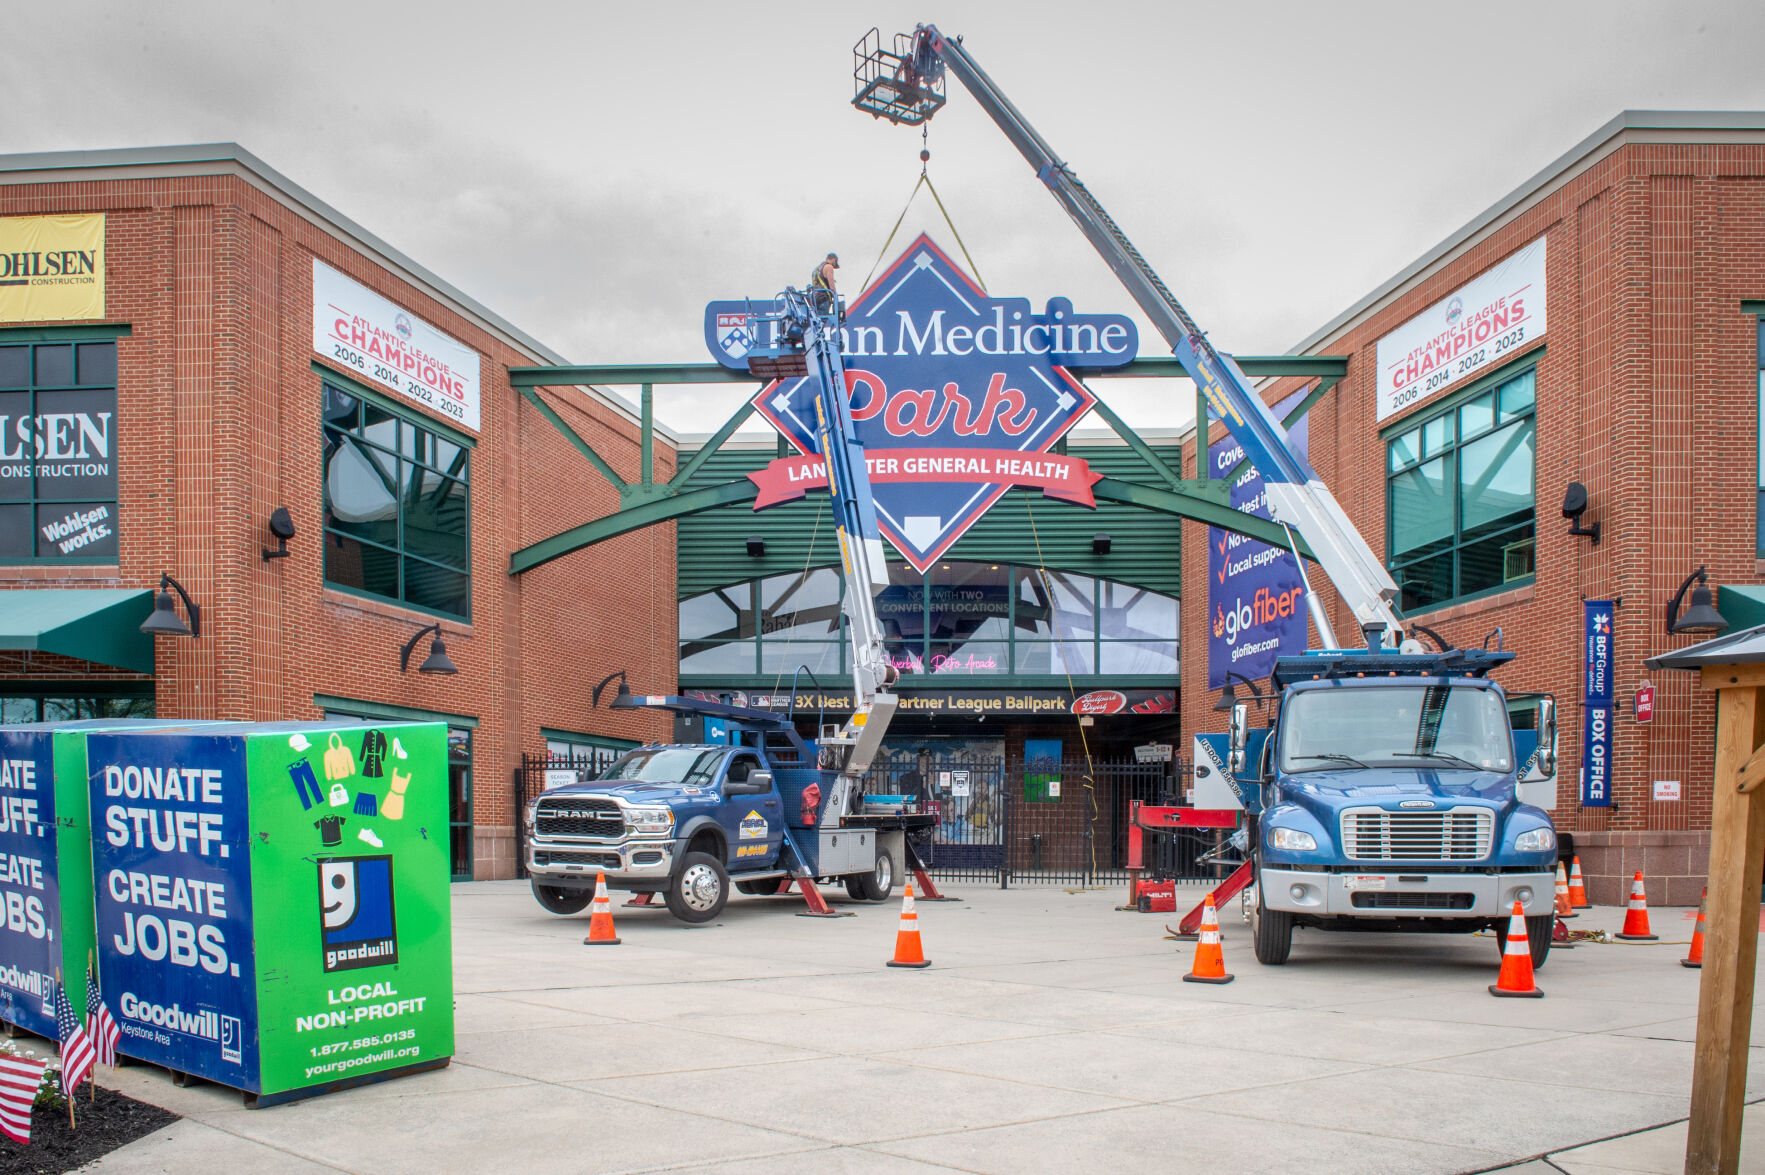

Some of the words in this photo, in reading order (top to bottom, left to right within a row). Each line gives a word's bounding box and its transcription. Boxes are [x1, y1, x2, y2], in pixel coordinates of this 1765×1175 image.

[32, 277, 95, 285] CONSTRUCTION
[352, 315, 407, 351] ATLANTIC
[410, 345, 450, 375] LEAGUE
[895, 306, 1129, 356] Medicine
[1393, 299, 1525, 388] CHAMPIONS
[1407, 327, 1457, 363] ATLANTIC
[1460, 297, 1506, 332] LEAGUE
[335, 319, 464, 400] CHAMPIONS
[1393, 387, 1418, 409] 2006
[1426, 370, 1449, 391] 2014
[1458, 350, 1486, 374] 2022
[1496, 327, 1525, 353] 2023
[334, 344, 364, 369] 2006
[374, 364, 399, 386] 2014
[408, 382, 433, 403] 2022
[441, 398, 464, 419] 2023
[841, 368, 1037, 436] Park
[788, 457, 899, 482] LANTER
[904, 457, 991, 474] GENERAL
[995, 459, 1070, 480] HEALTH
[42, 505, 109, 543] Wohlsen
[58, 522, 112, 554] works.
[1228, 553, 1253, 577] Local
[881, 603, 949, 613] CONVENENT
[951, 603, 1009, 613] LOCATIONS
[934, 591, 958, 600] WITH
[961, 591, 984, 600] TWO
[965, 653, 997, 674] Arcade
[1231, 637, 1279, 662] glofiber.com
[795, 695, 814, 708] 3X
[818, 695, 850, 708] Best
[898, 696, 943, 710] artner
[948, 696, 1002, 712] League
[1005, 695, 1065, 712] Ballpark
[1592, 709, 1606, 742] BOX
[1201, 738, 1224, 766] USDOT
[105, 765, 223, 803] DONATE
[1221, 767, 1243, 796] 956596
[1590, 745, 1606, 799] OFFICE
[557, 810, 594, 818] RAM
[106, 805, 229, 858] STUFF.
[108, 869, 227, 918] CREATE
[114, 912, 240, 978] JOBS.
[327, 940, 394, 968] goodwill
[328, 982, 397, 1005] LOCAL
[120, 992, 219, 1040] Goodwill
[296, 997, 426, 1033] NON-PROFIT
[121, 1021, 154, 1041] Keystone
[155, 1030, 171, 1046] Area
[310, 1029, 416, 1057] 1.877.585.0135
[305, 1046, 420, 1078] yourgoodwill.org
